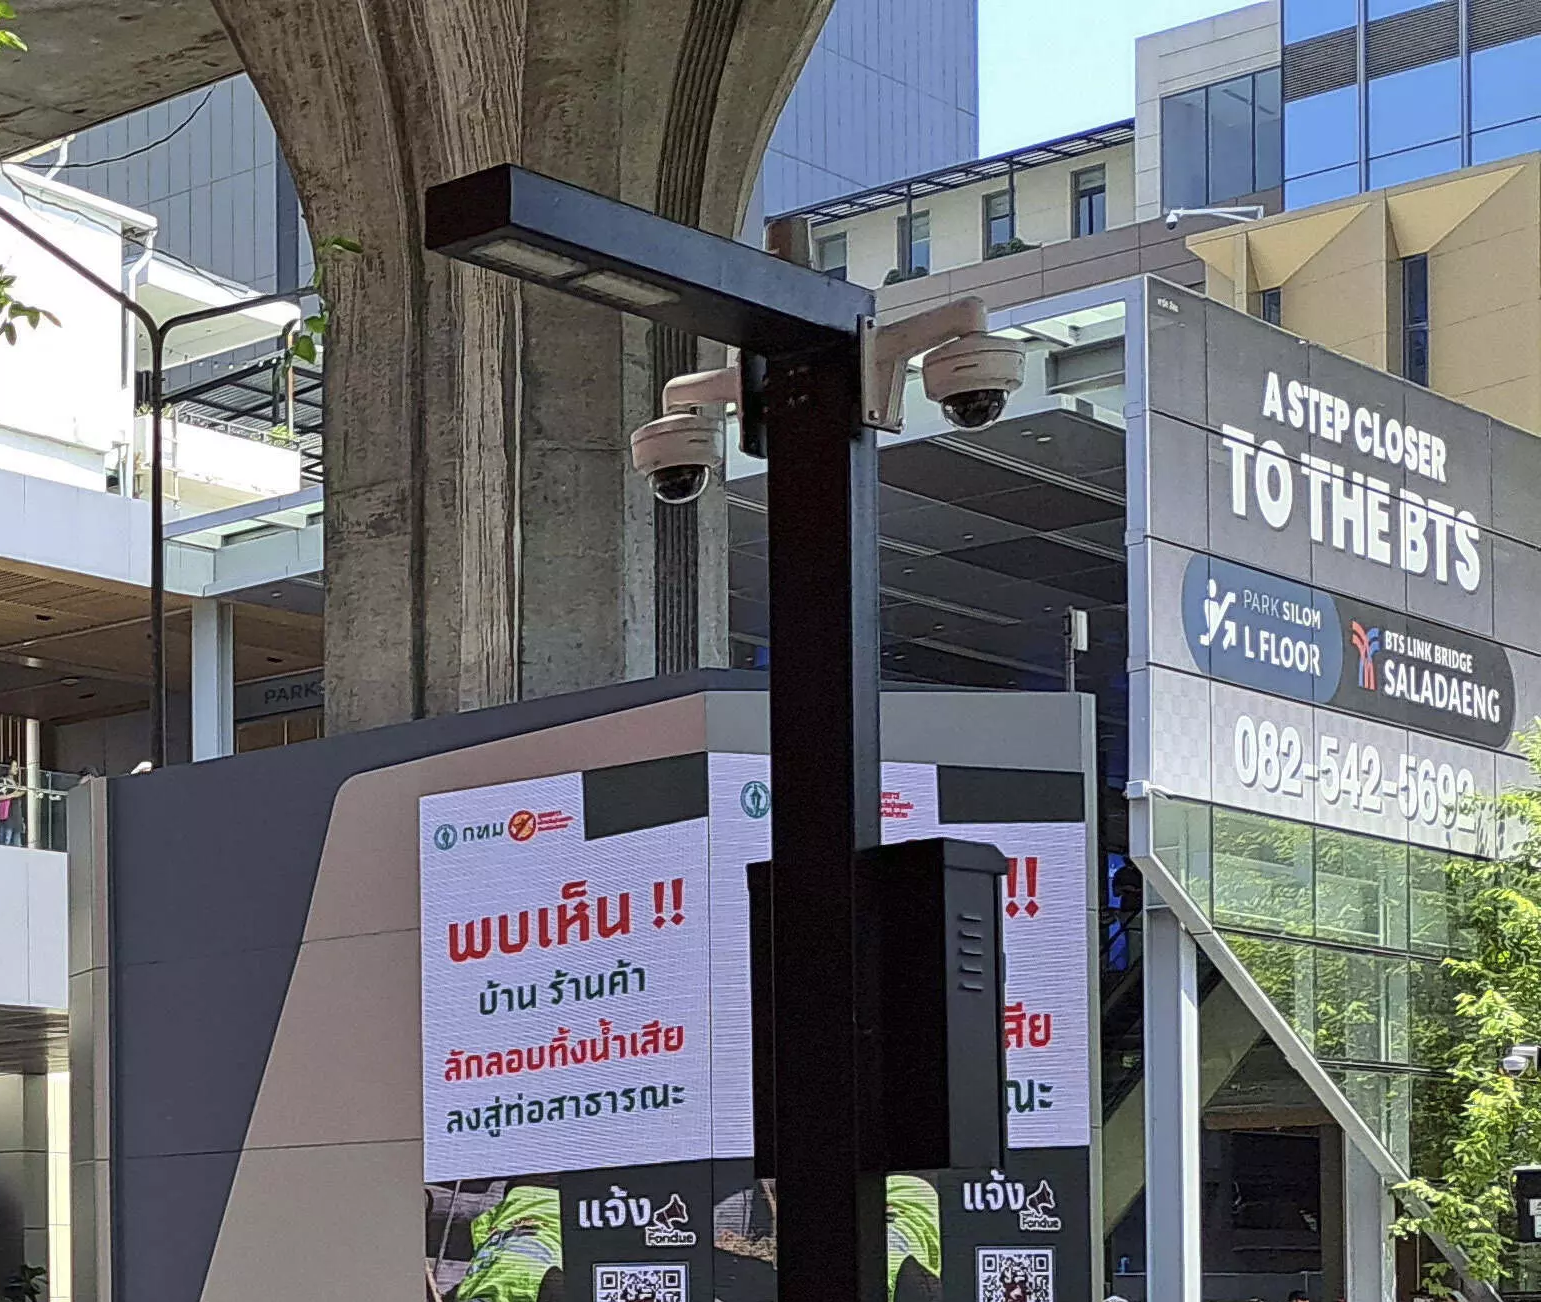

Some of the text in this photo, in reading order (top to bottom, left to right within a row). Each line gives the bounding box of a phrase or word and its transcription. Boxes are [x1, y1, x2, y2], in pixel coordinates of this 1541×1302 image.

[1262, 371, 1448, 484] A STEP CLOSER
[1222, 423, 1482, 594] TO THE BTS
[1243, 588, 1322, 631] PARK SILOM
[1244, 637, 1321, 678] L FLOOR
[1384, 629, 1473, 675] BTS LINK BRIDGE
[1384, 660, 1501, 724] SALADAENG
[1234, 715, 1477, 834] 082-542-5692
[446, 878, 686, 963] พบเห็น !!
[478, 961, 647, 1017] บ้าน ร้านค้า
[444, 1018, 685, 1082] ลักลอบทิ้งน้ำเสีย
[446, 1082, 686, 1137] ลงสู่ท่อสาธารณะ
[579, 1185, 651, 1229] แจ้ง
[962, 1168, 1025, 1211] แจ้ง
